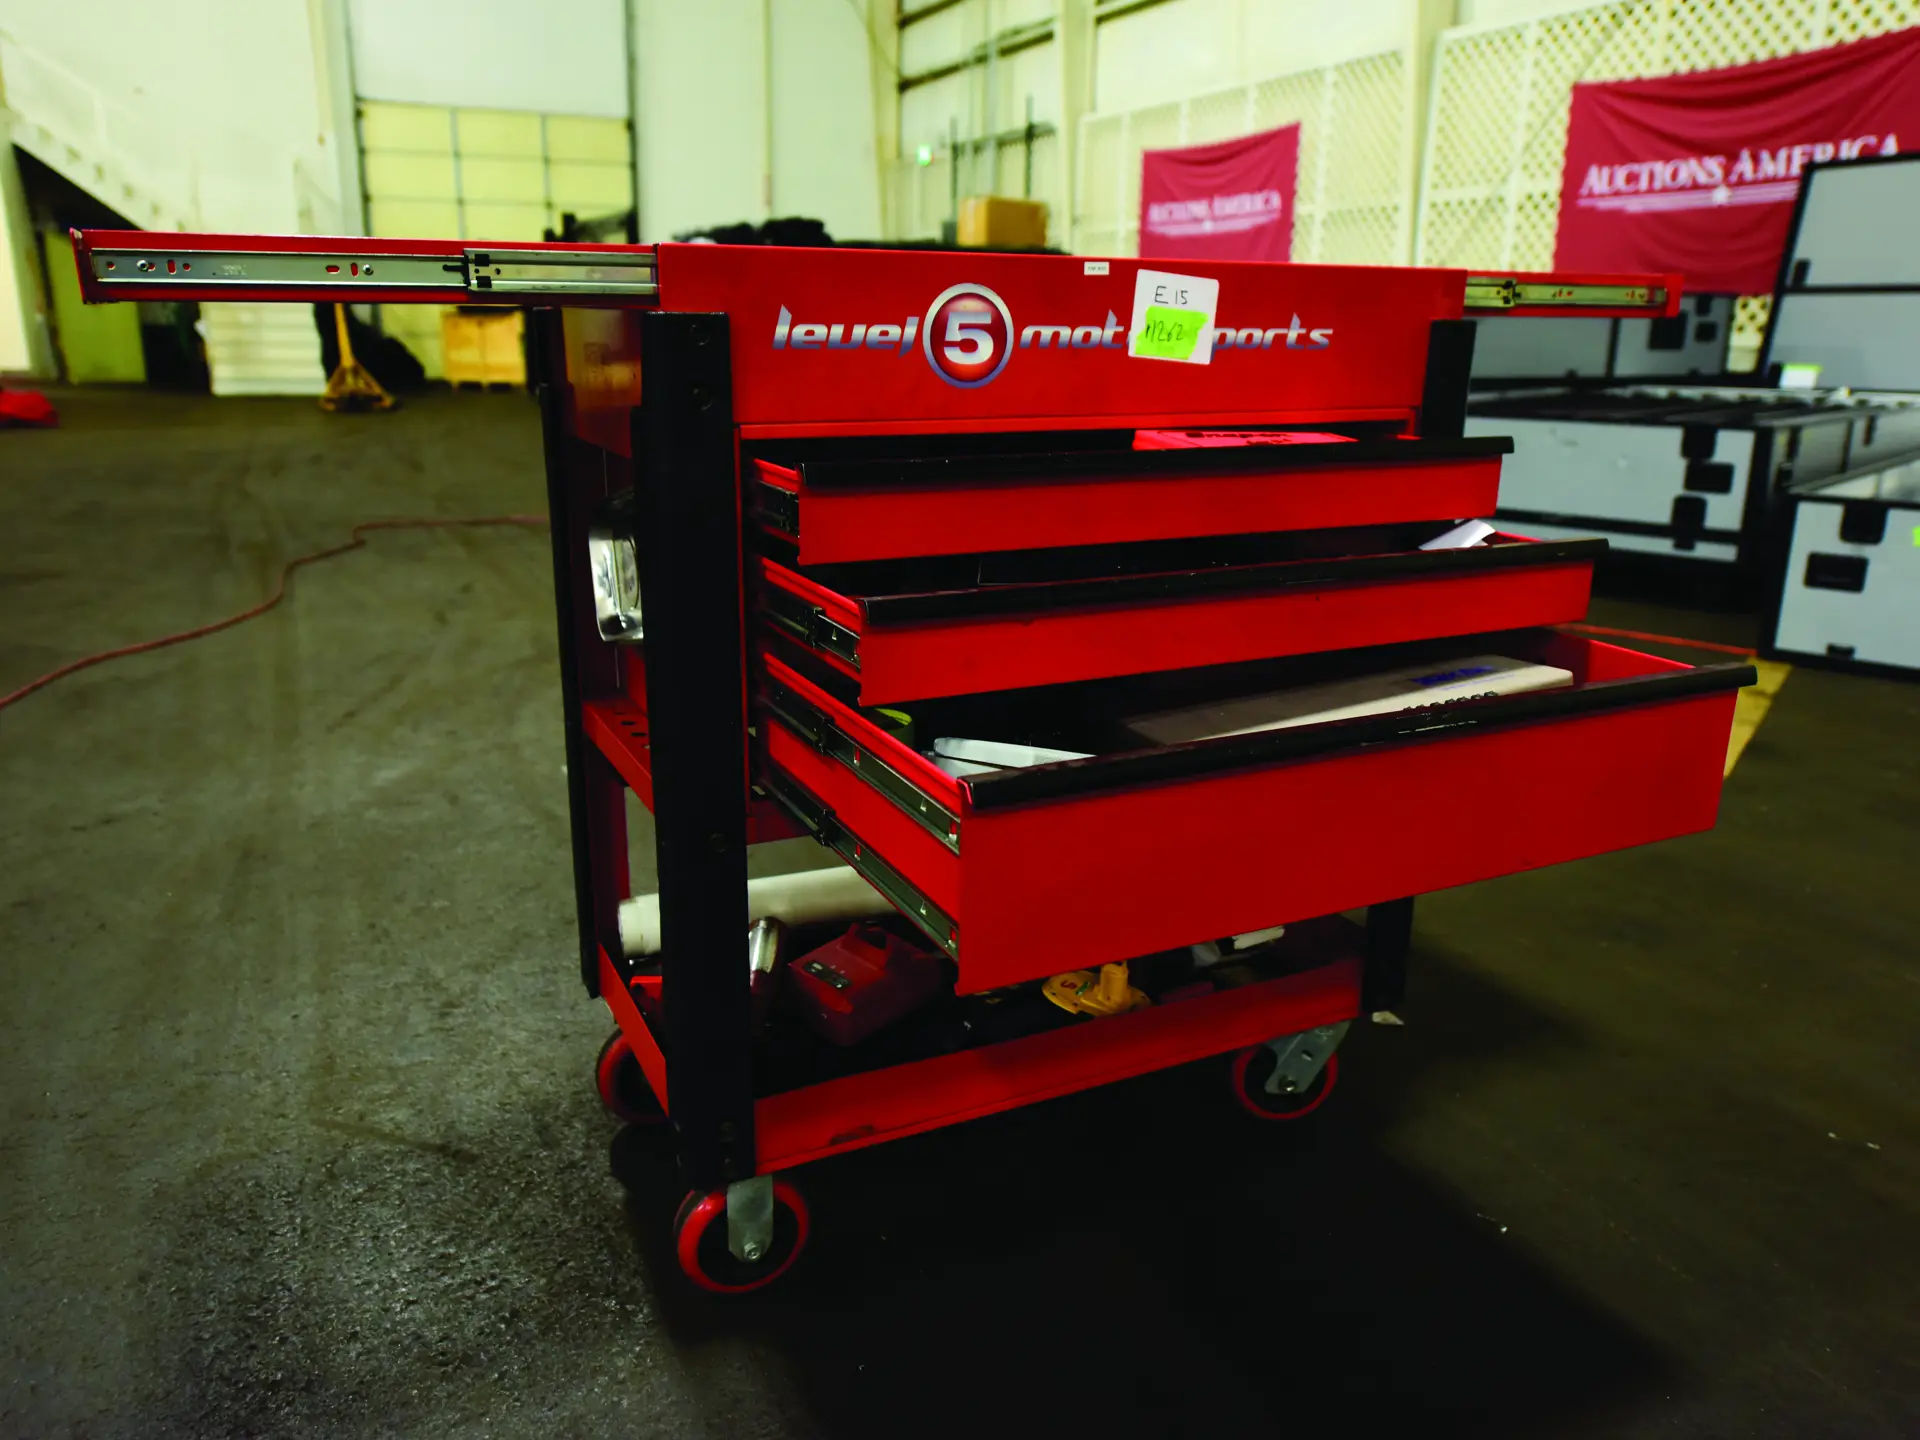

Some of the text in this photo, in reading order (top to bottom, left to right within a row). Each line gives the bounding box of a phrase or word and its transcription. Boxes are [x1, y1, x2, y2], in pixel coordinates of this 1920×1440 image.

[1578, 155, 1727, 198] AUCTIONS
[943, 312, 994, 365] 5
[1020, 309, 1334, 361] motports
